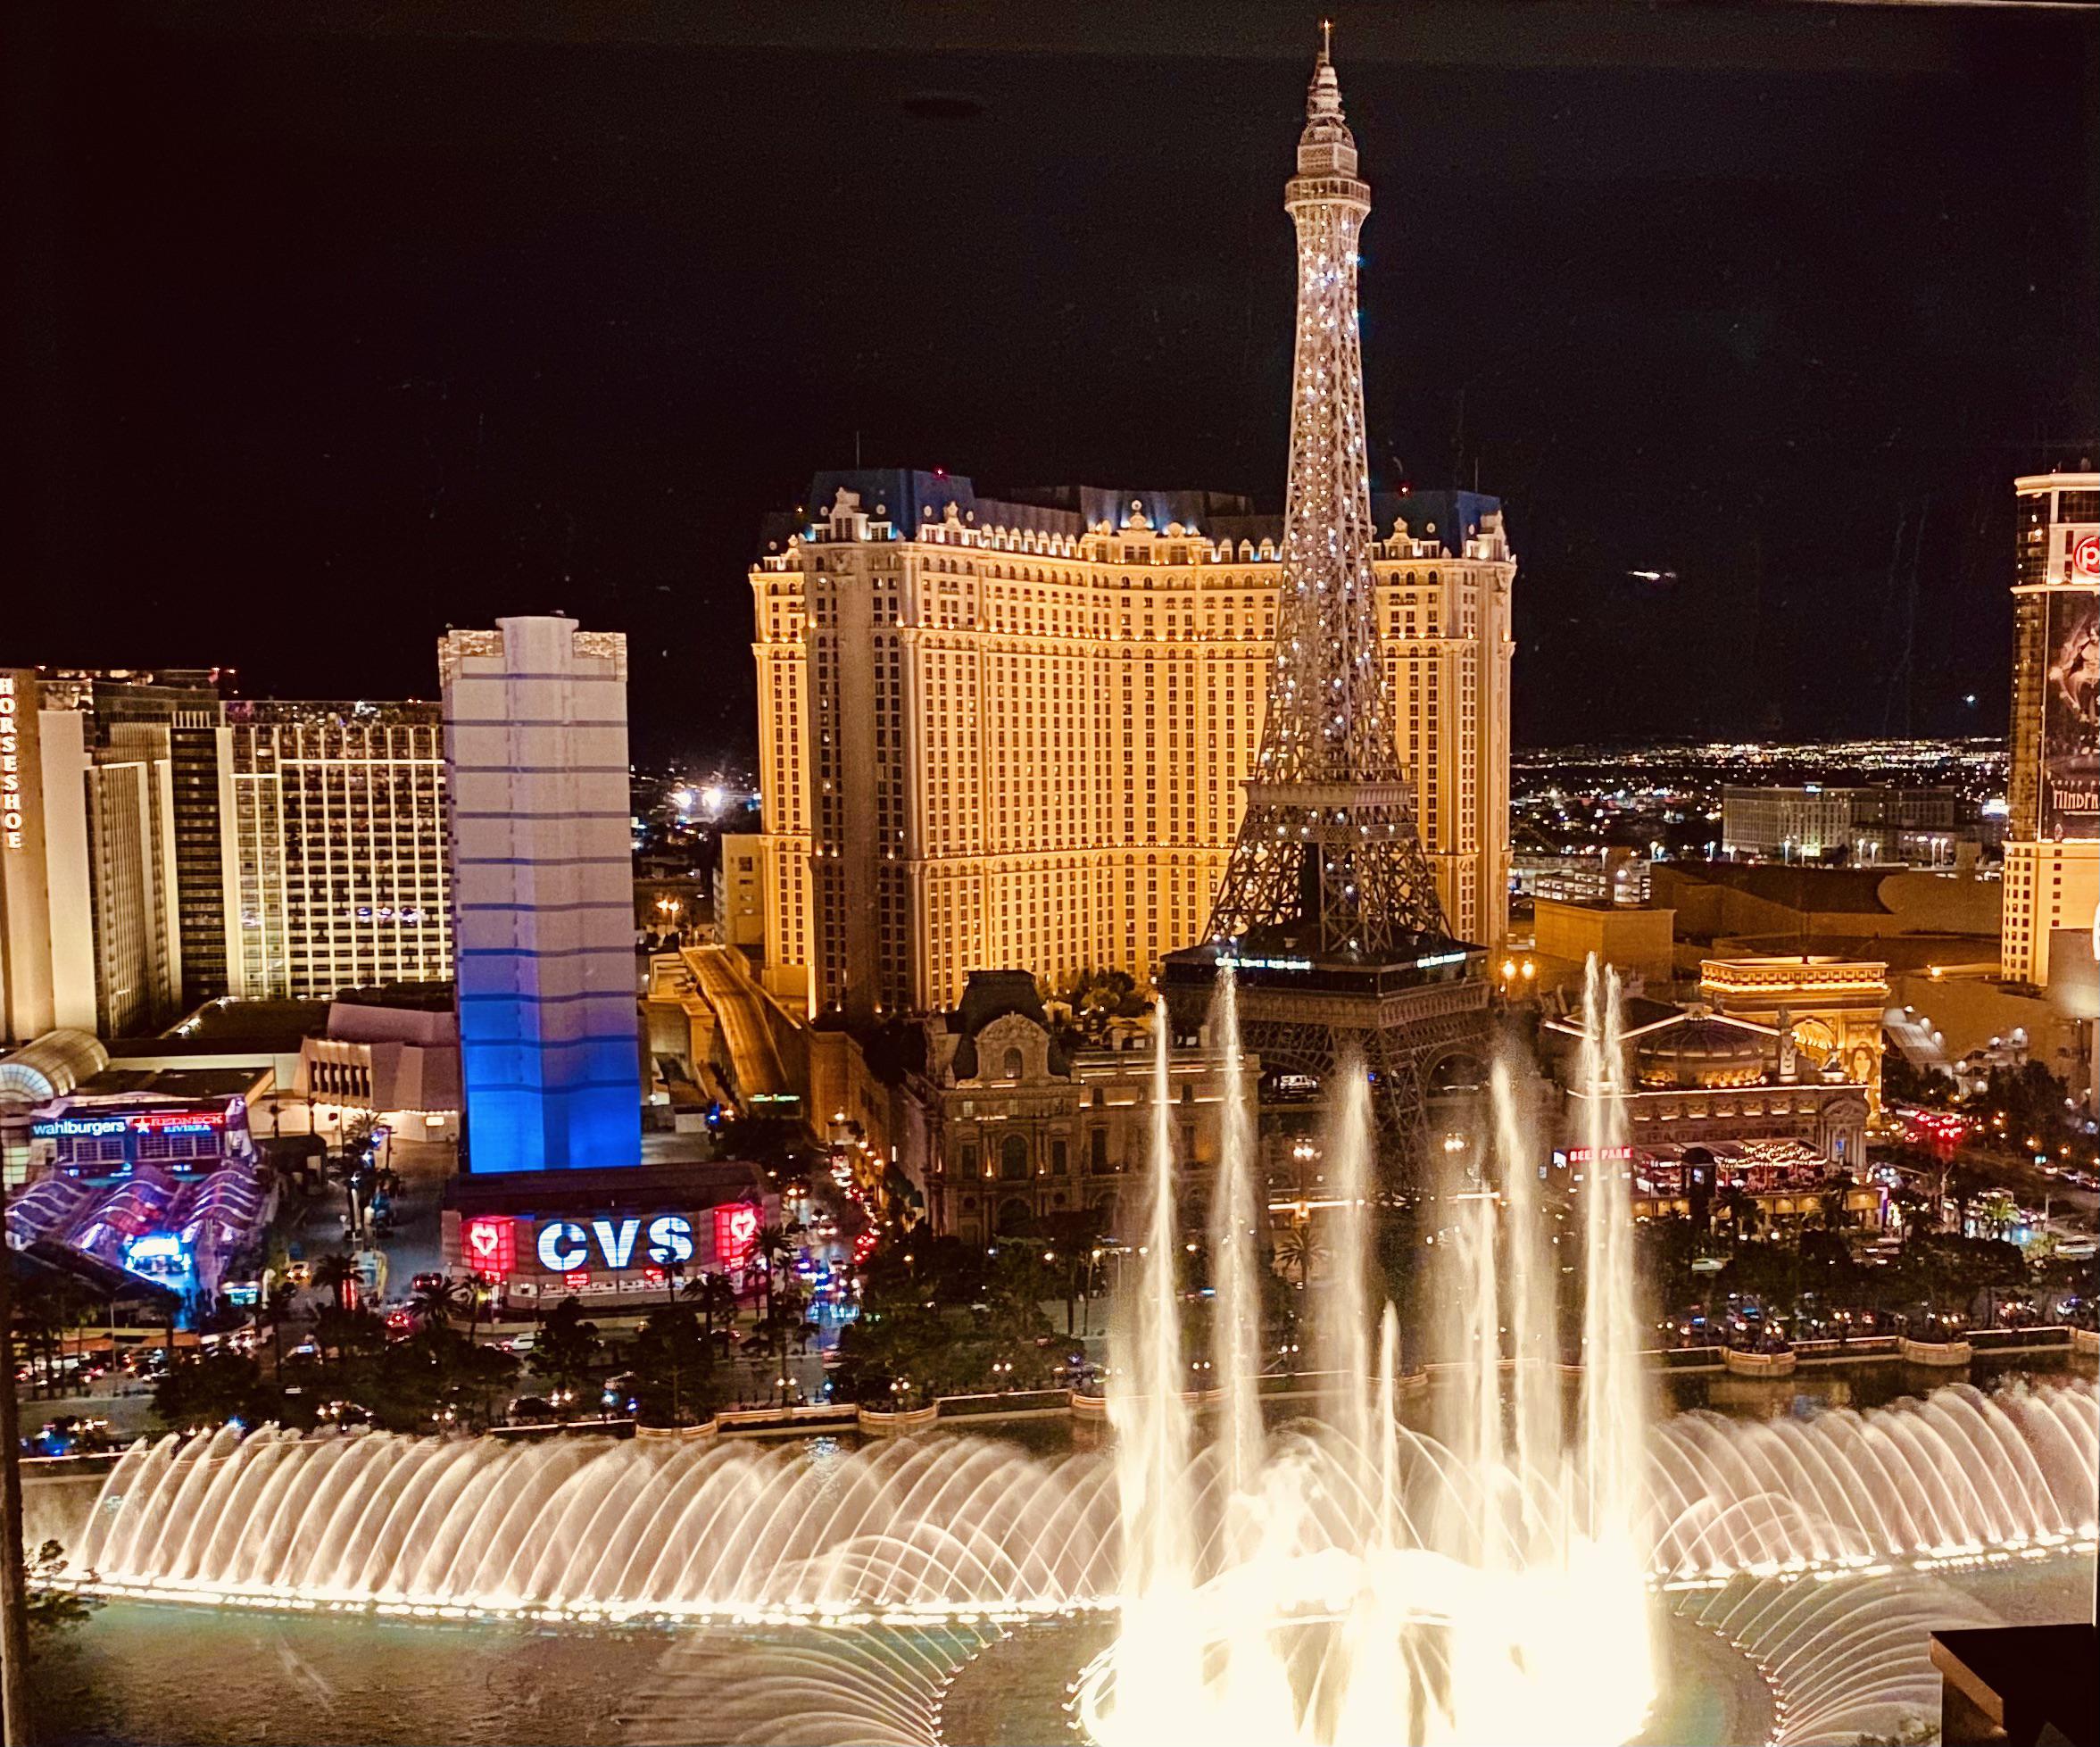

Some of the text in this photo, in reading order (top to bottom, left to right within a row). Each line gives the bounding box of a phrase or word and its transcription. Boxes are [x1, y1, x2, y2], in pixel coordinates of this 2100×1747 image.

[0, 678, 22, 848] HORSESHOE
[33, 1120, 125, 1136] wahlburgers
[150, 1115, 222, 1126] REDNECK
[537, 1217, 693, 1271] CVS
